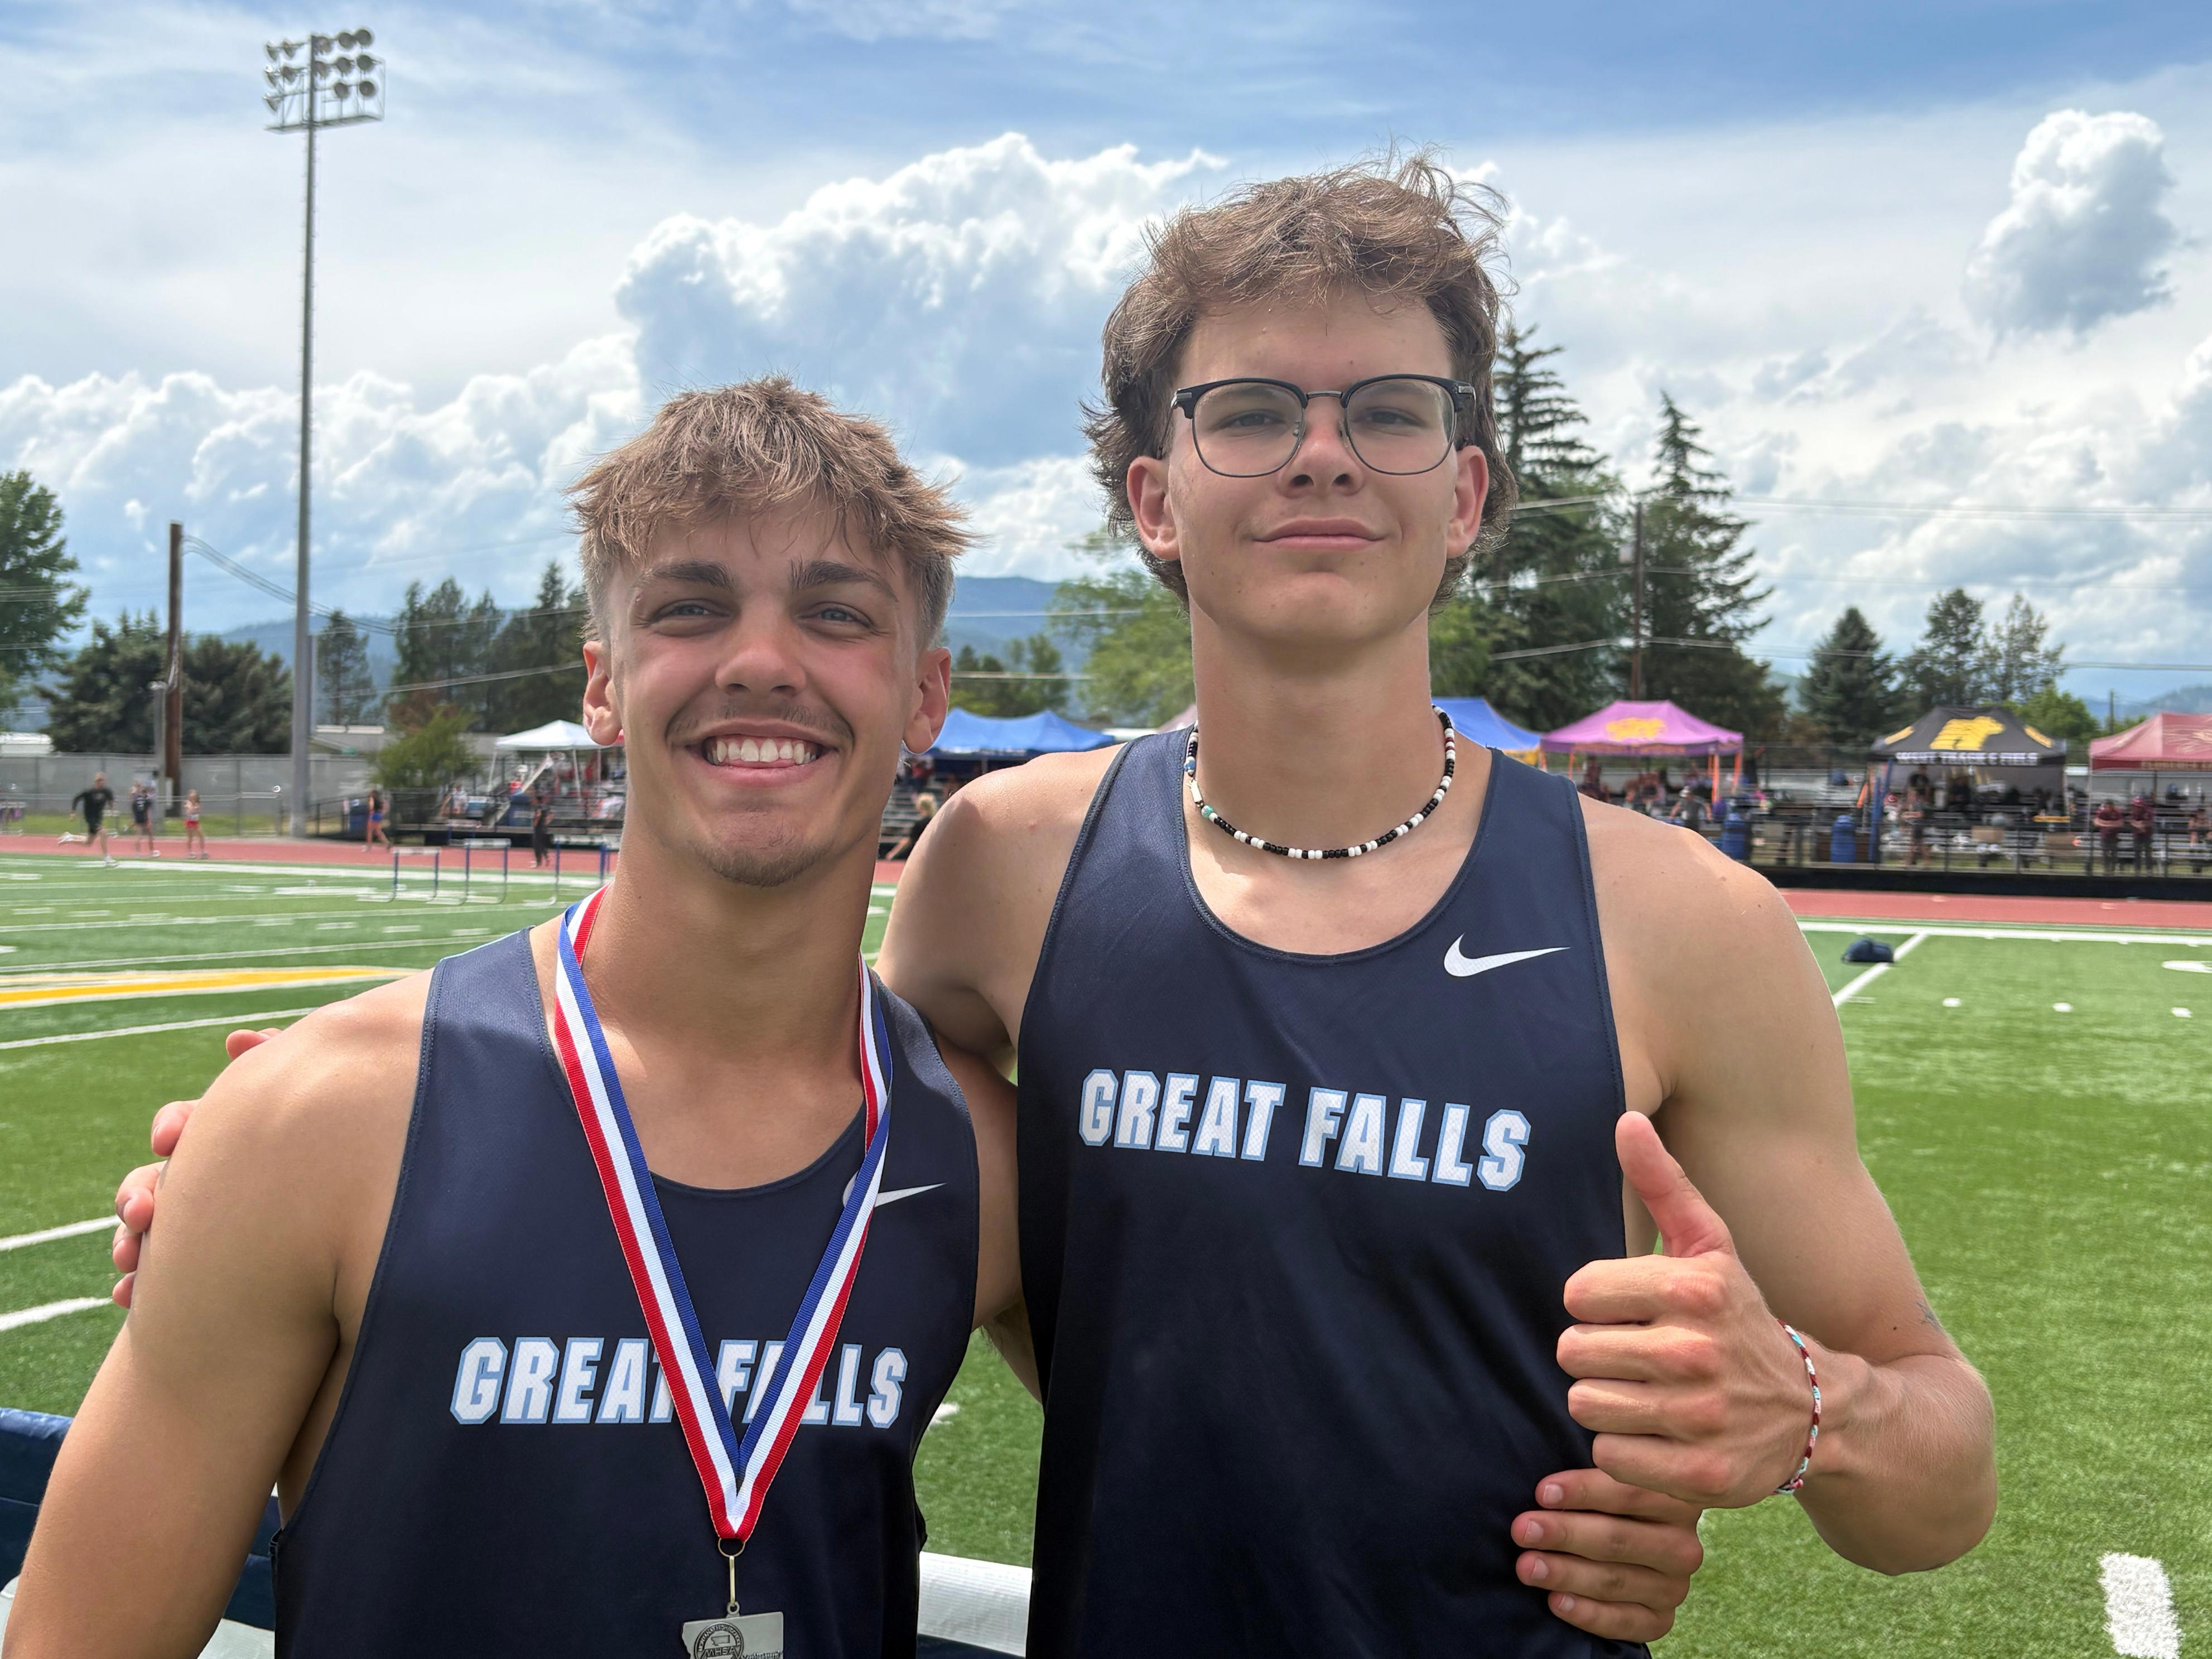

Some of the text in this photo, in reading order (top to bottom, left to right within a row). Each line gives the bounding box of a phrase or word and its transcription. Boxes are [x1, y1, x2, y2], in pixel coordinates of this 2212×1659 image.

[1079, 1069, 1531, 1192] GREAT FALLS
[704, 1646, 737, 1657] MHSA
